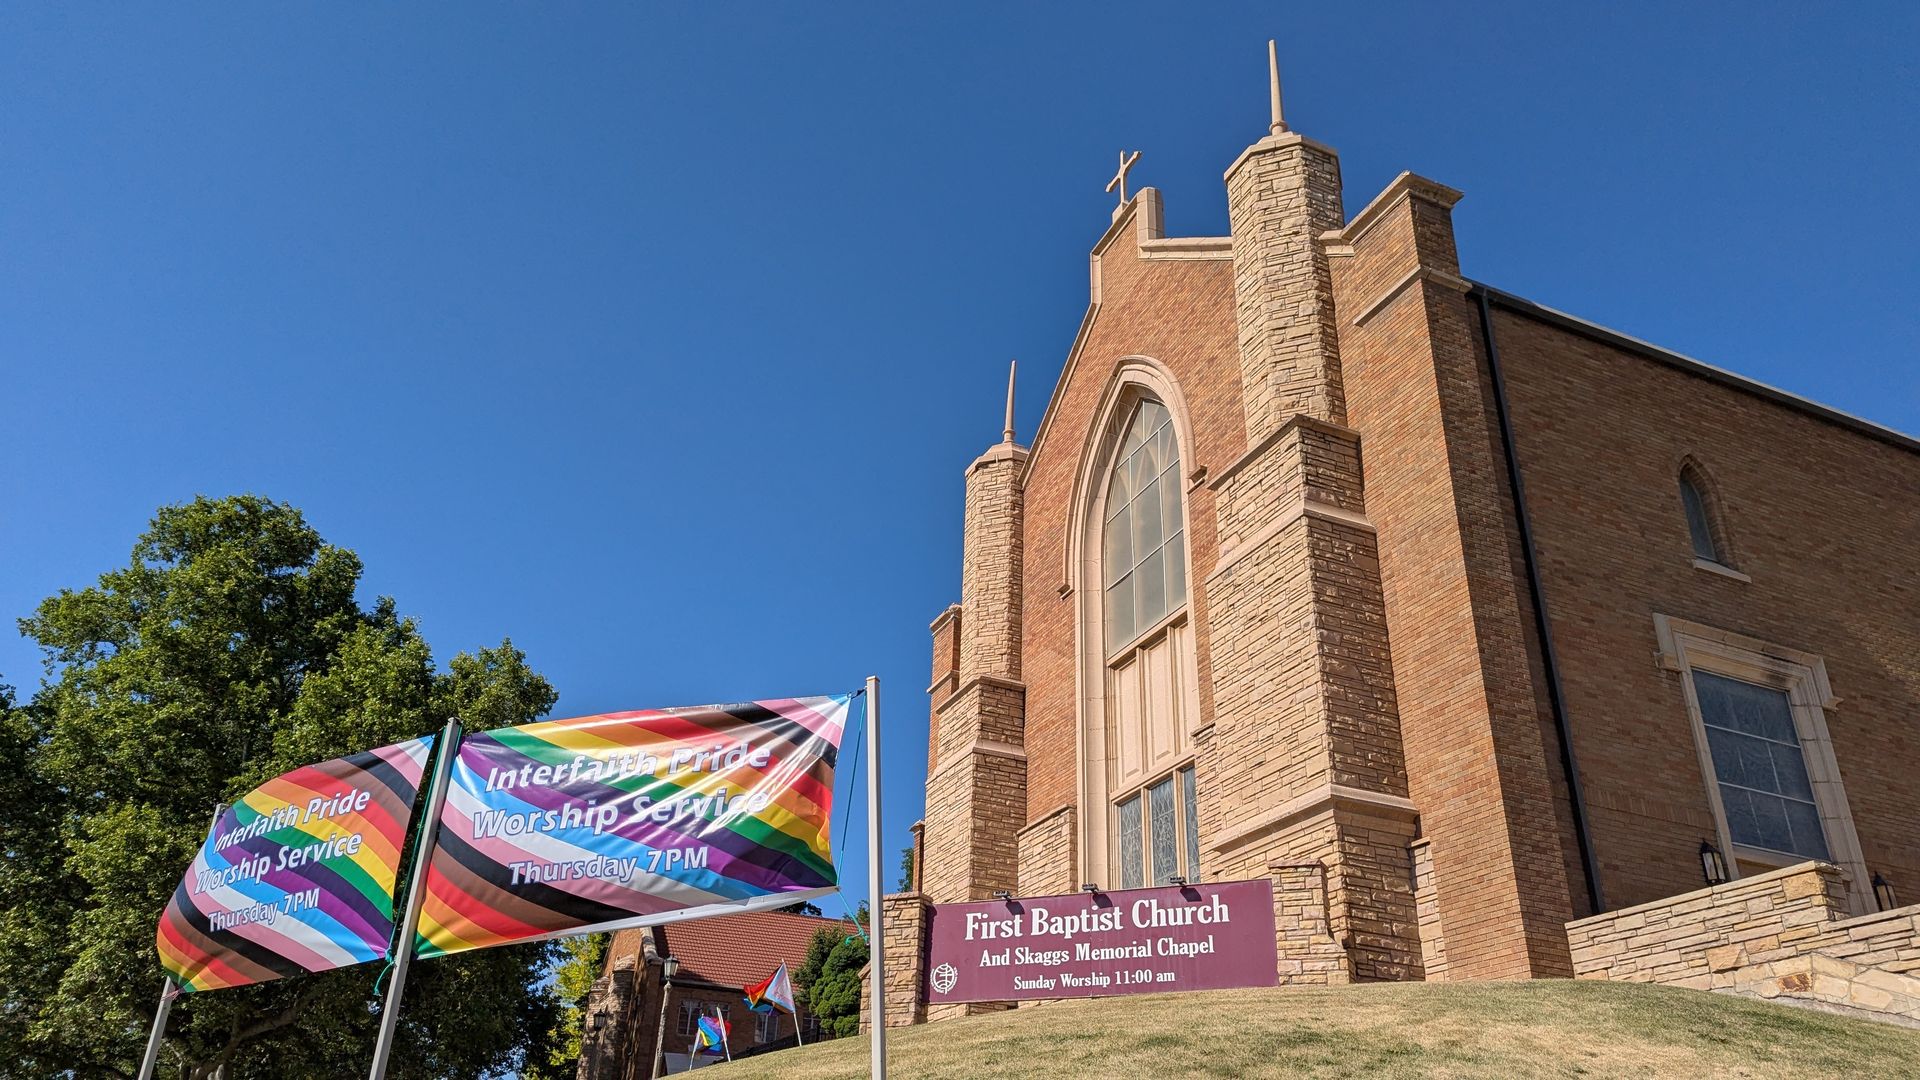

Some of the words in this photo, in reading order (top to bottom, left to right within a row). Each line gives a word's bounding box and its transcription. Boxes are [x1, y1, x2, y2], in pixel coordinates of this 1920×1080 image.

[485, 750, 657, 793] Interfaith
[668, 743, 772, 775] Pride
[214, 805, 297, 852] Interfaith
[302, 789, 371, 824] Pride
[473, 801, 618, 840] Worship
[194, 856, 271, 894] Worship
[276, 832, 362, 871] Service
[509, 854, 638, 886] Thursday
[647, 846, 708, 872] 7PM
[208, 901, 278, 933] Thursday
[283, 888, 320, 914] 7PM
[965, 911, 1022, 941] First
[1030, 906, 1124, 939] Baptist
[1131, 895, 1230, 928] Church
[979, 946, 1010, 967] And
[1014, 946, 1070, 966] Skaggs
[1075, 940, 1152, 962] Memorial
[1157, 935, 1215, 959] Chapel
[1014, 975, 1057, 992] Sunday
[1061, 971, 1111, 989] Worship
[1115, 970, 1153, 986] 11:00
[1156, 971, 1176, 983] am
